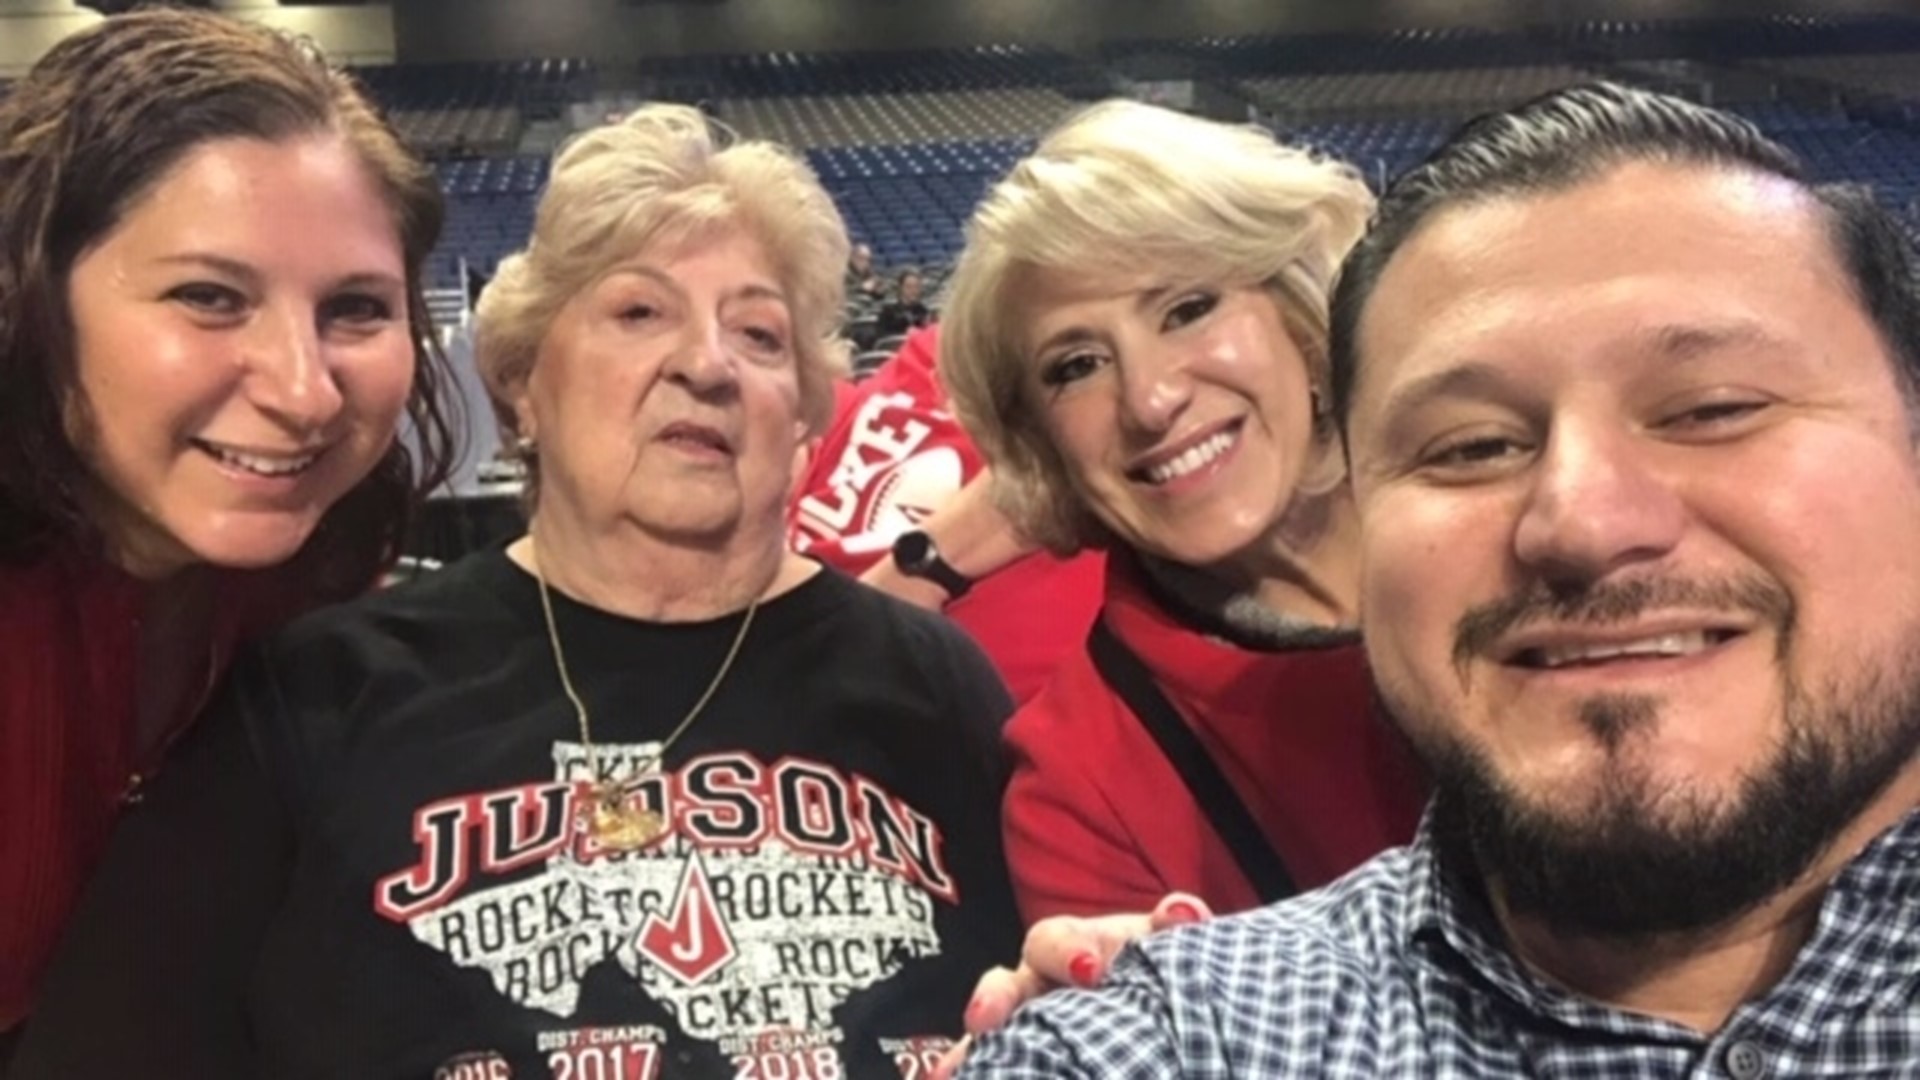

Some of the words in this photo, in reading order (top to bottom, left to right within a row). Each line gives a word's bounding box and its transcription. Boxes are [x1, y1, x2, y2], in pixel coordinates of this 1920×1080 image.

[795, 390, 936, 552] CKE
[709, 869, 927, 922] ROCKETS
[664, 981, 850, 1030] CKET
[548, 1043, 657, 1080] 2017
[730, 1047, 838, 1080] 2018
